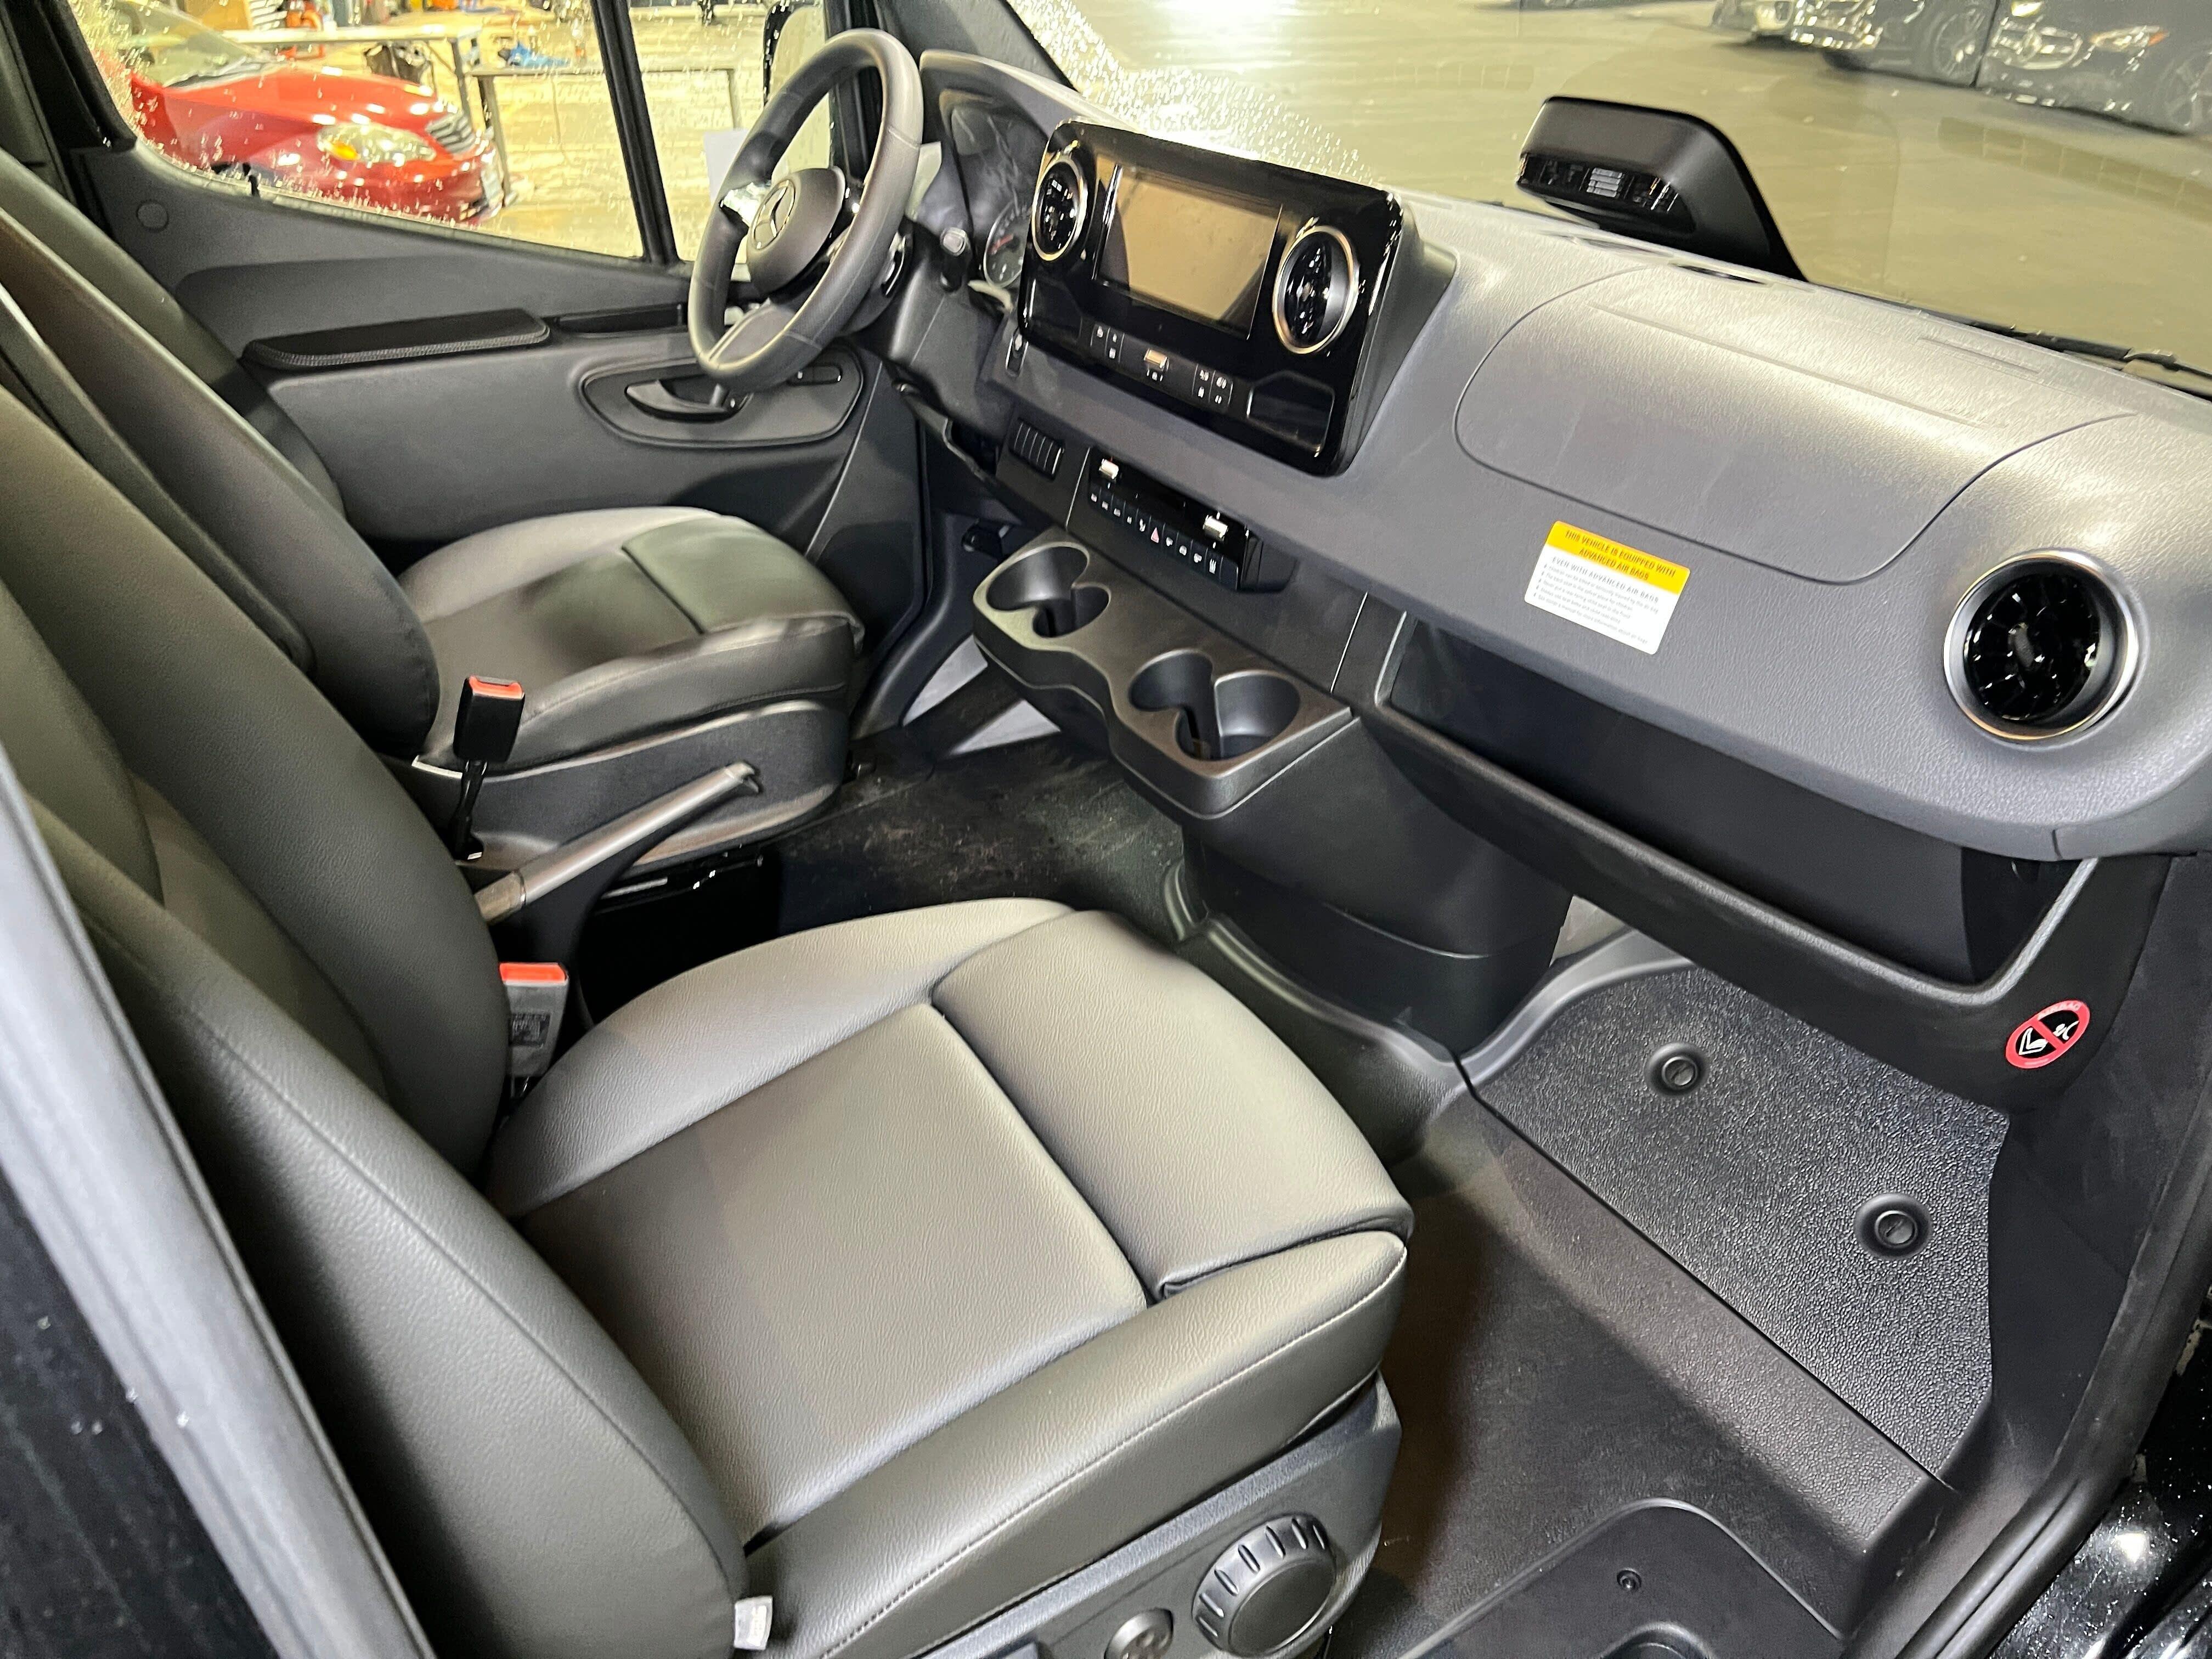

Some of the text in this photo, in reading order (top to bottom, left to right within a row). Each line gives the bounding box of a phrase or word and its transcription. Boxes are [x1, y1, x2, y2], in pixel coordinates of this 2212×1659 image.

[1565, 530, 1677, 578] THIS VEHICLE IS EQUIPPED WITH
[1579, 547, 1649, 580] ADVANCED AIR BAGS
[1552, 556, 1659, 603] EVEN WITH ADVANCED AIR BAGS
